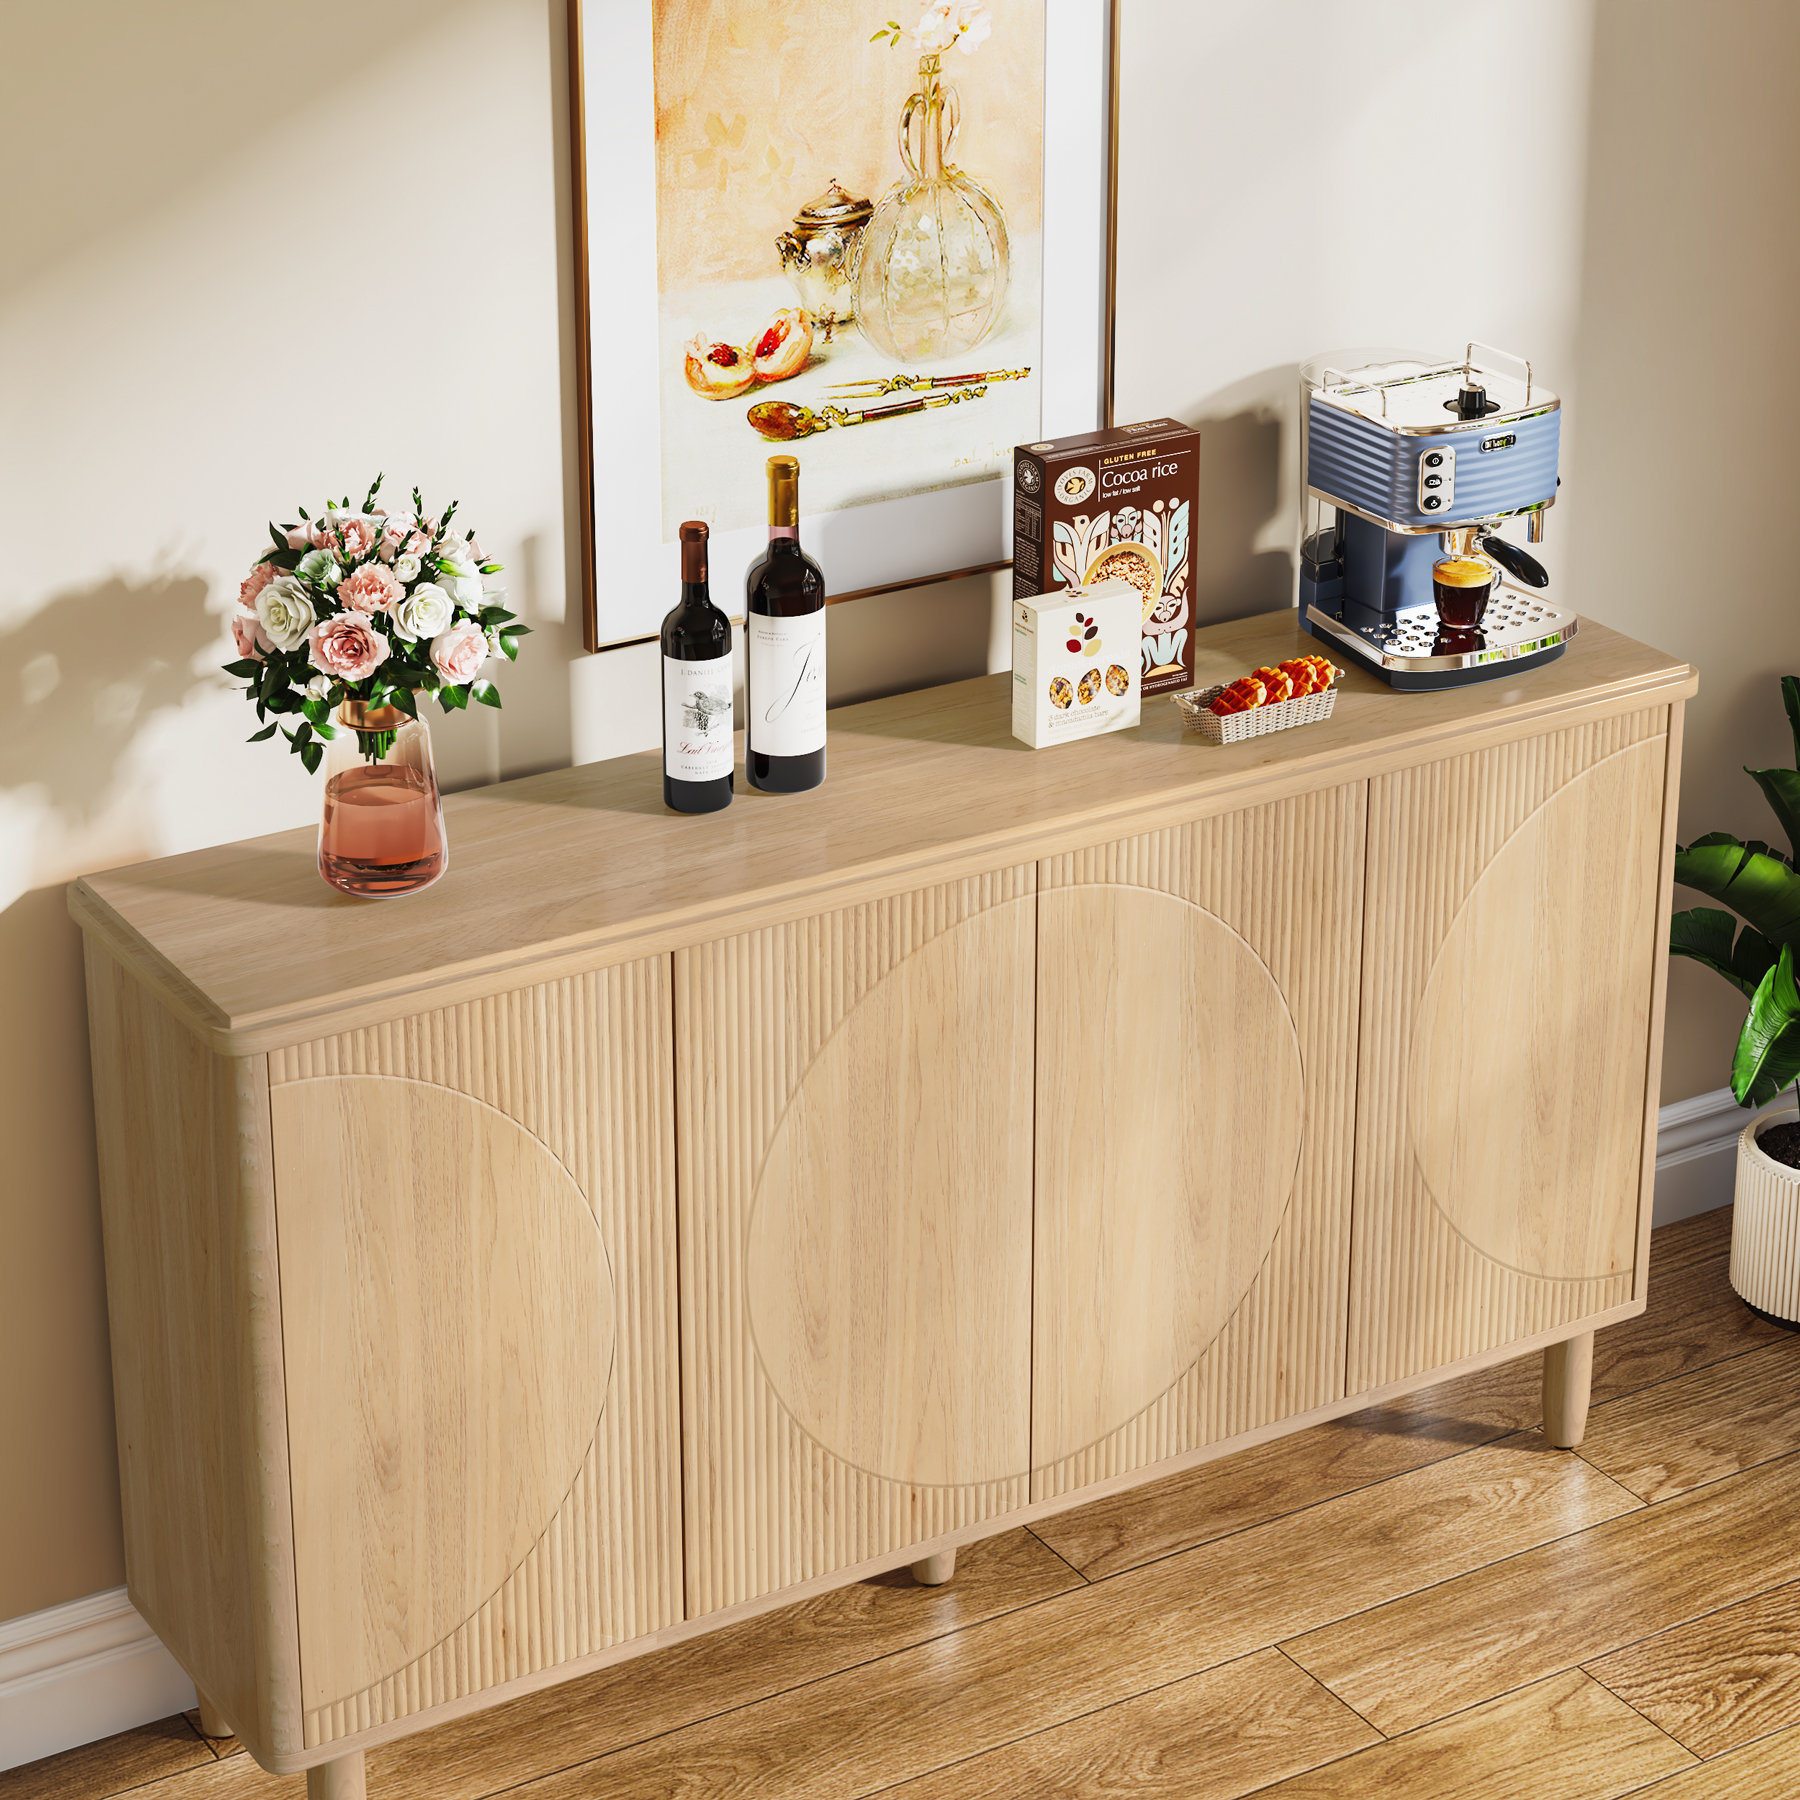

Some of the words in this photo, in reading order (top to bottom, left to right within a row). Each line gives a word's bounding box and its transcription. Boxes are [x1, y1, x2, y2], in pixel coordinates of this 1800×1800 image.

[1103, 453, 1135, 465] GLUTEN
[1136, 448, 1157, 459] FREE
[1102, 468, 1148, 488] Cocoa
[1152, 461, 1179, 478] rice
[1122, 487, 1132, 495] low
